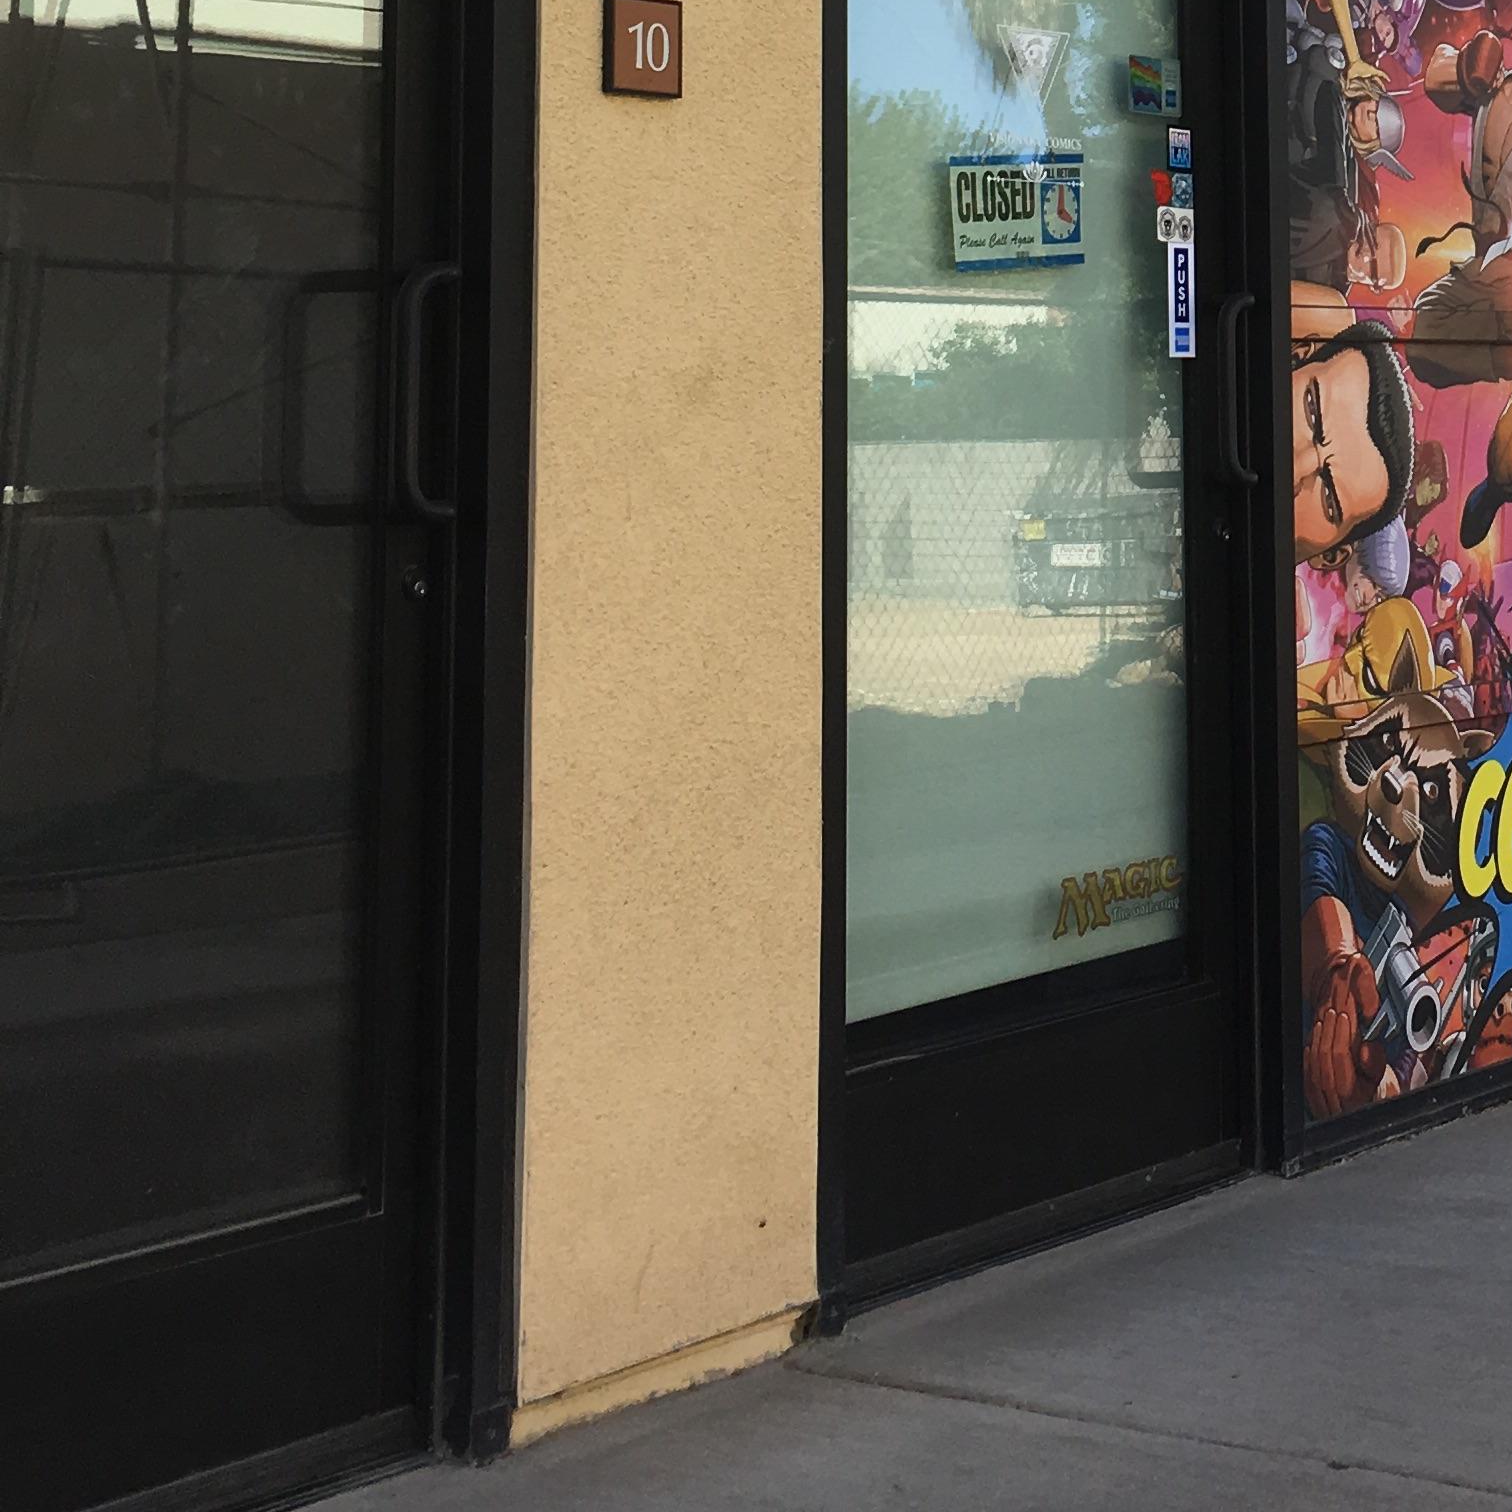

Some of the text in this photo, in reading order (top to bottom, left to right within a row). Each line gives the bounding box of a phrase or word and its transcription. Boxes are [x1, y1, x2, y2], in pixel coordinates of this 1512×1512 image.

[628, 21, 670, 72] 10
[956, 169, 1036, 223] CLOSED
[960, 231, 1035, 248] Please Call Again
[1177, 253, 1187, 318] PUSH
[1052, 855, 1183, 940] MAGIC
